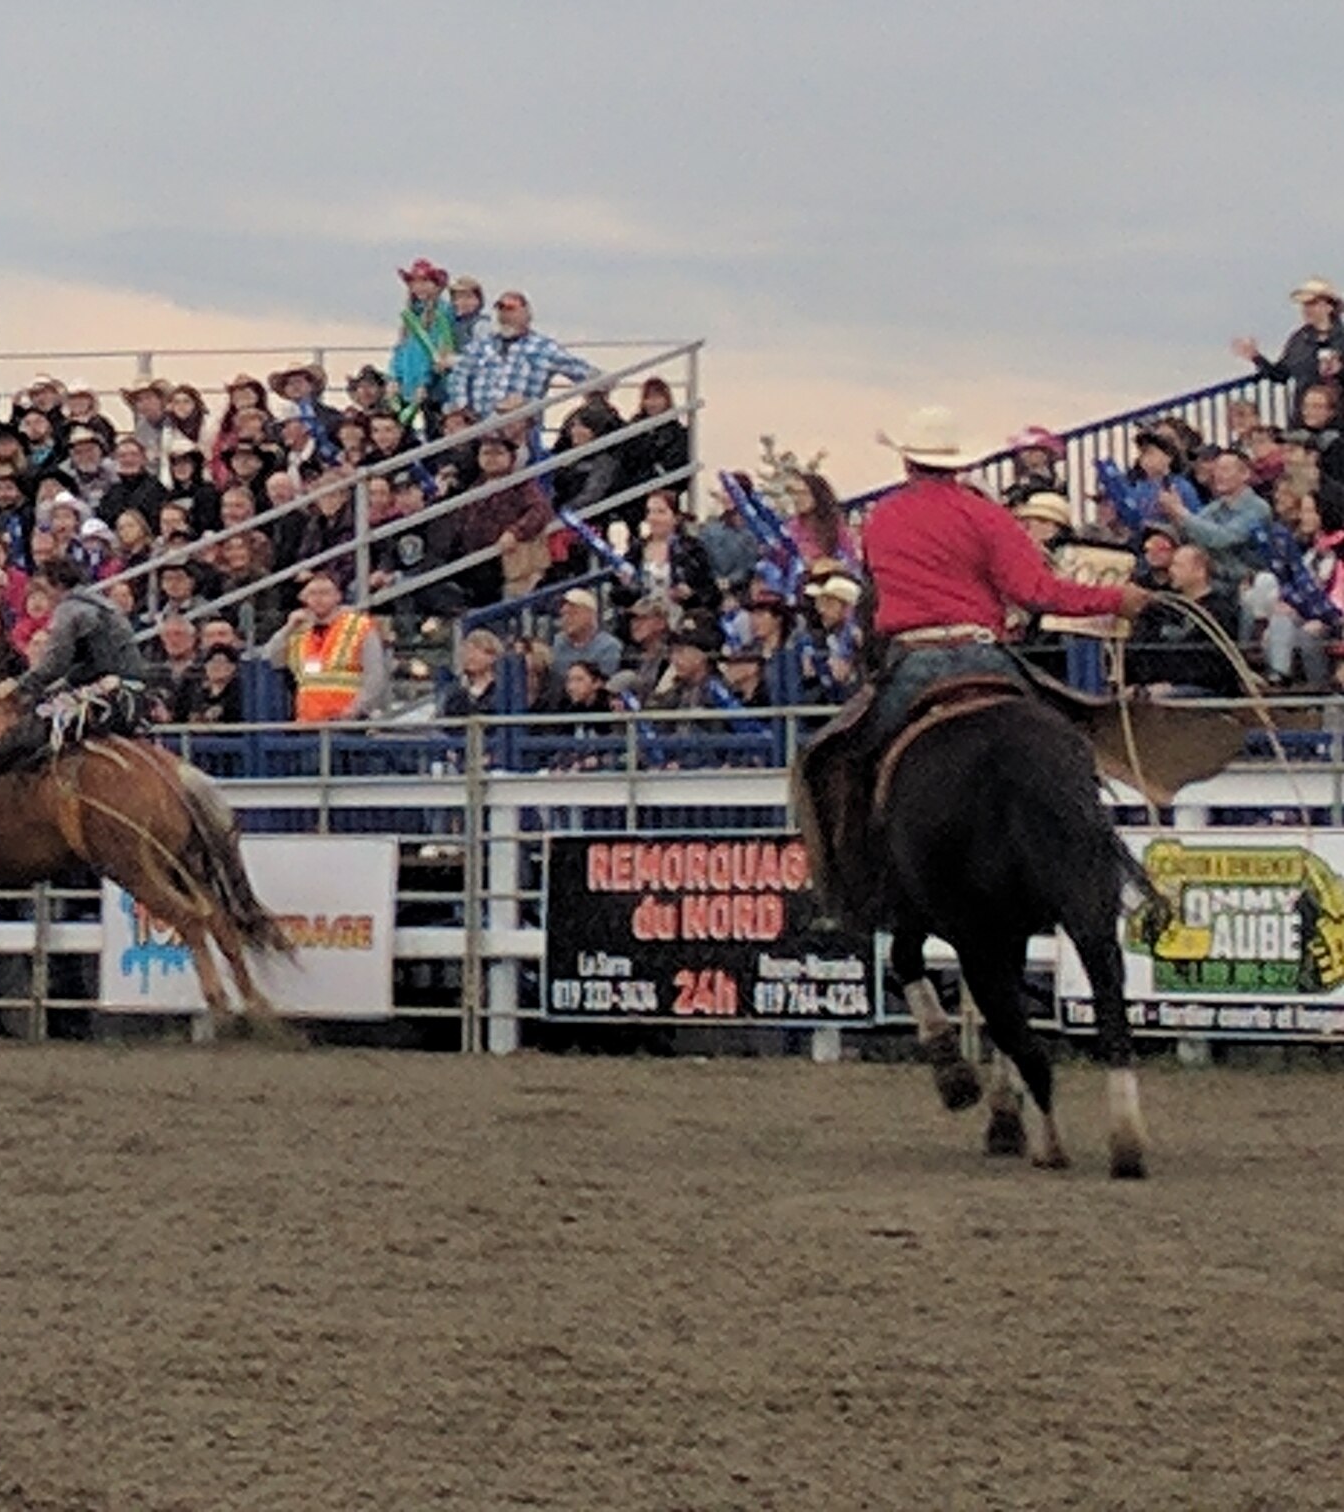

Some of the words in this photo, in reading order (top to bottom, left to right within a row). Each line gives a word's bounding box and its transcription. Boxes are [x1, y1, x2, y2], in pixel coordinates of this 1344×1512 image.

[588, 843, 813, 891] REMORQUAG
[682, 894, 784, 941] NORD
[673, 970, 738, 1015] 24h
